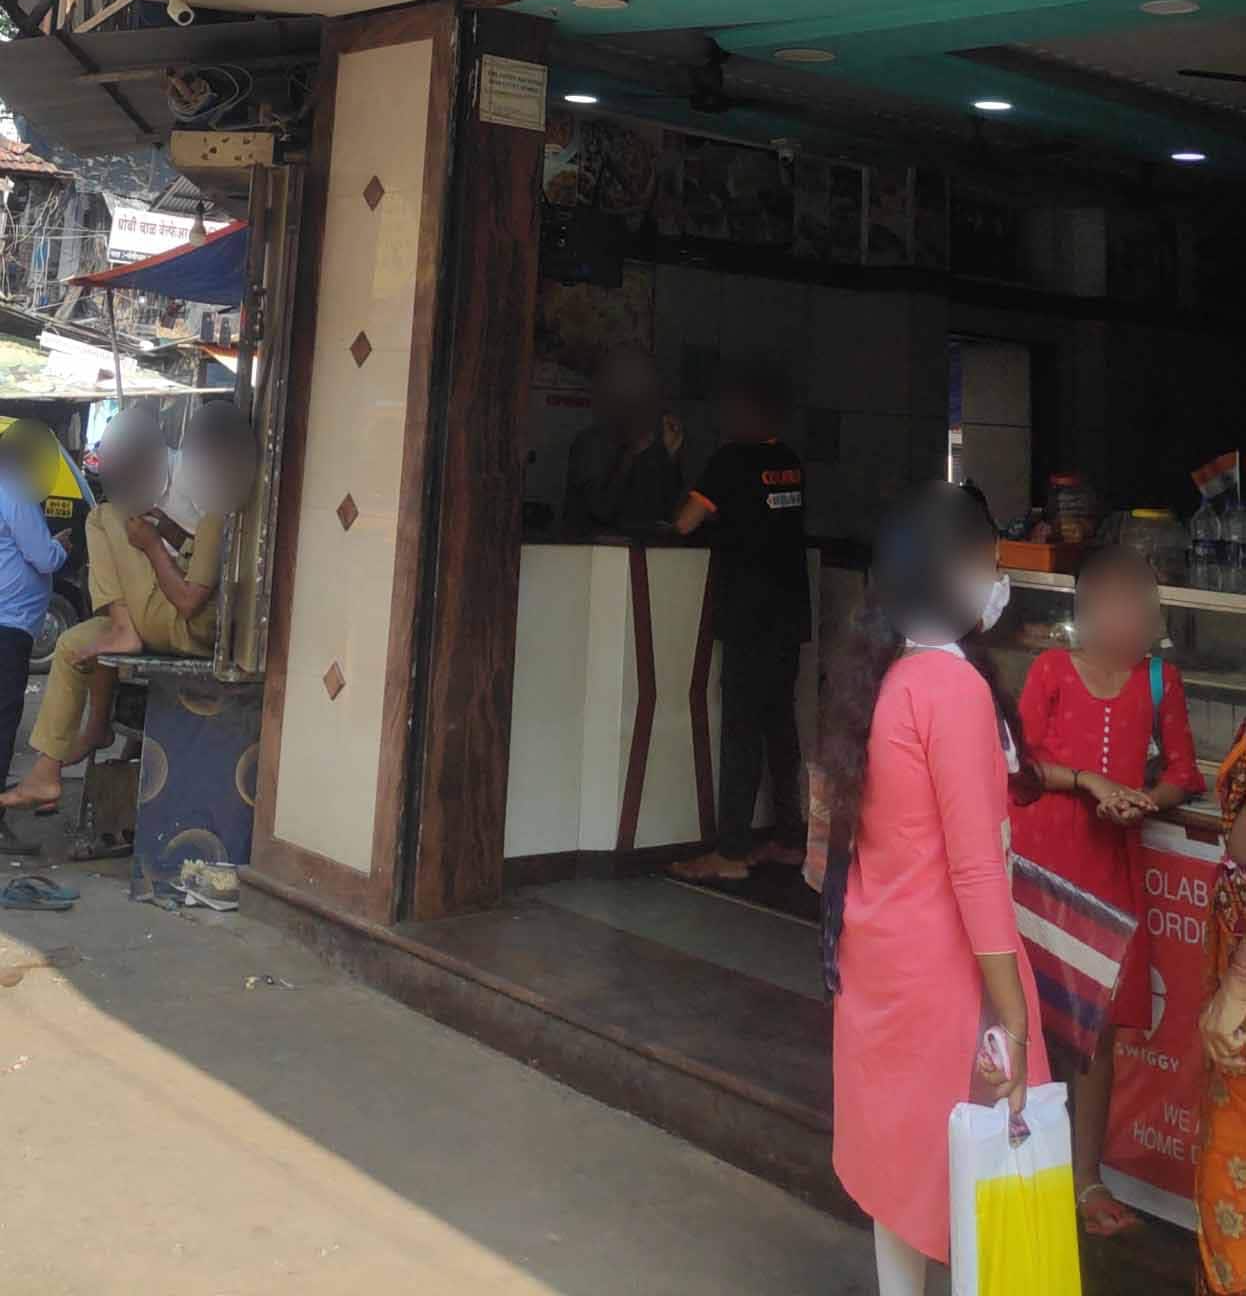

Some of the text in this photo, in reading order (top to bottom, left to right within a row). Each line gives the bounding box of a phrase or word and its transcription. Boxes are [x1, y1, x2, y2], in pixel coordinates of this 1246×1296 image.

[1144, 868, 1209, 907] OLAB
[1163, 1101, 1191, 1134] WE
[1132, 1119, 1186, 1161] HOME
